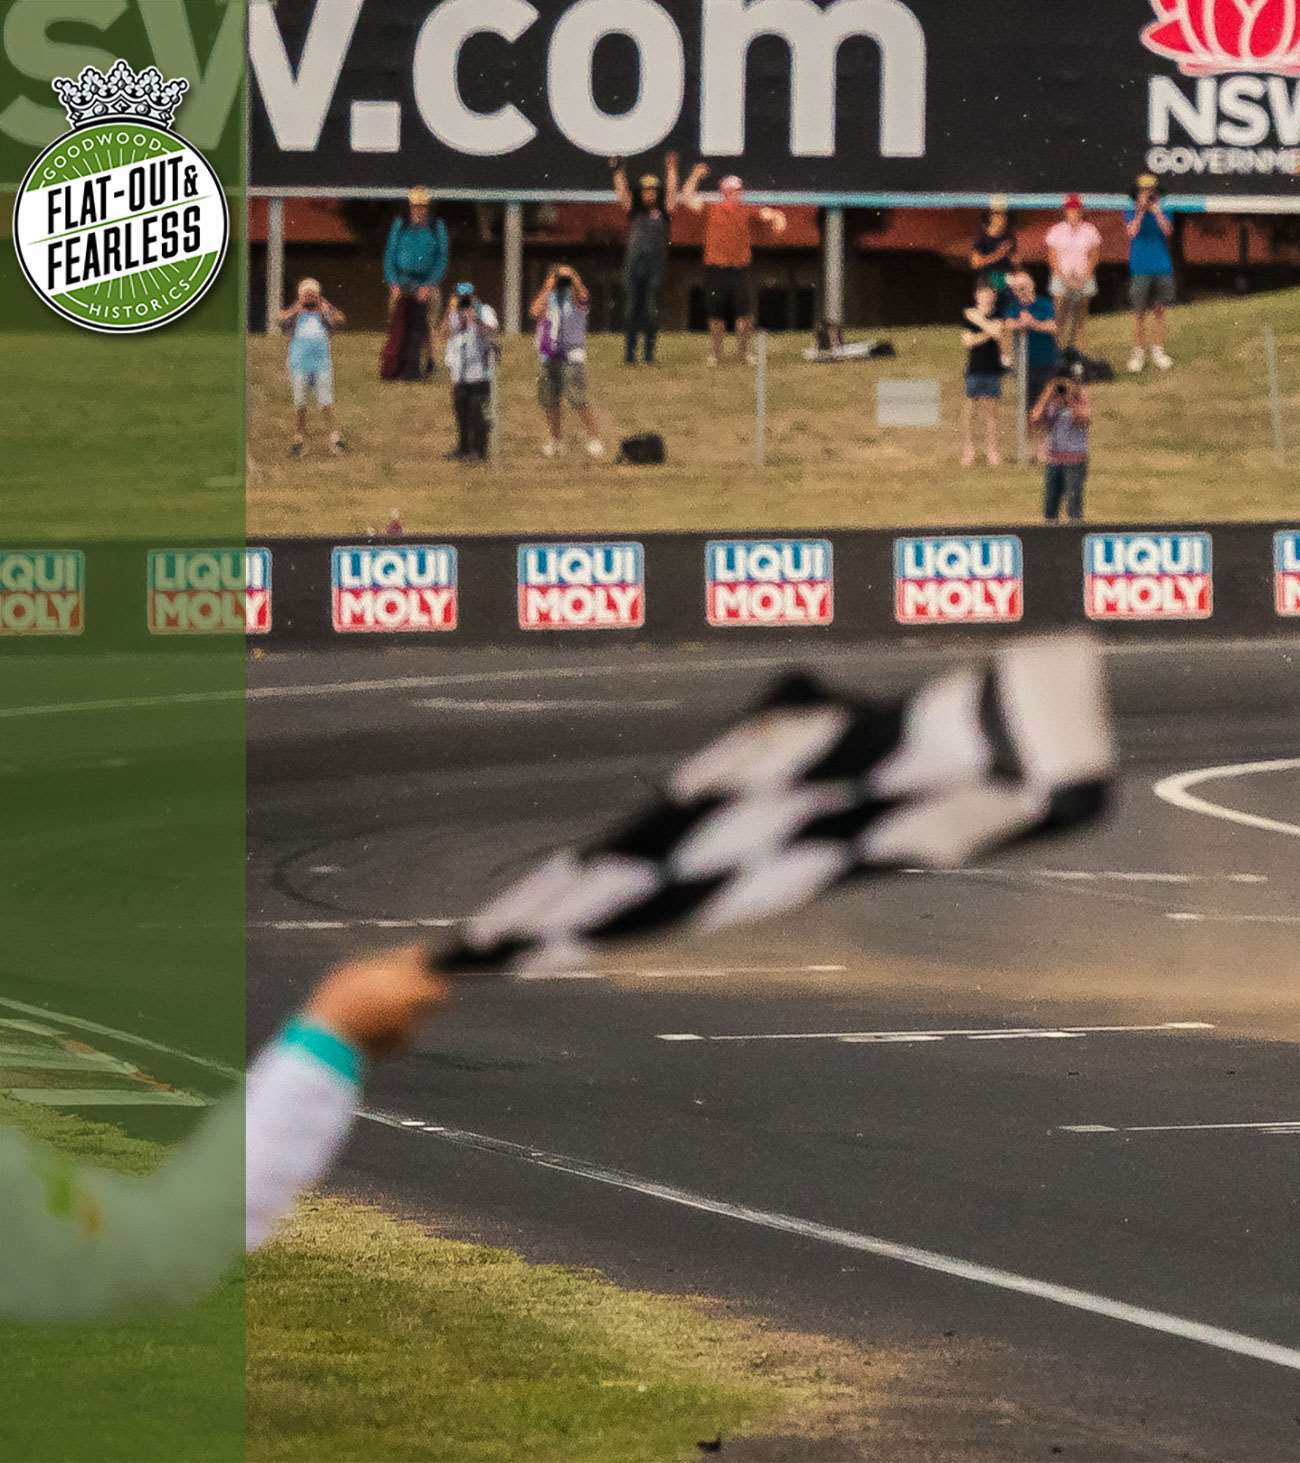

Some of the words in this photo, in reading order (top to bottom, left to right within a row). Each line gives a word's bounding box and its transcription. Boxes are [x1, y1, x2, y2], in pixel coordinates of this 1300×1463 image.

[154, 551, 264, 591] LIQUI
[340, 551, 449, 588] LIQUI
[526, 548, 635, 584] LIQUI
[716, 543, 823, 581] LIQUI
[904, 541, 1011, 578] LIQUI
[1094, 536, 1202, 574] LIQUI
[153, 591, 268, 630] MOLY
[340, 588, 454, 628] MOLY
[526, 584, 640, 625] MOLY
[715, 582, 829, 620] MOLY
[903, 578, 1018, 617] MOLY
[1093, 575, 1208, 613] MOLY
